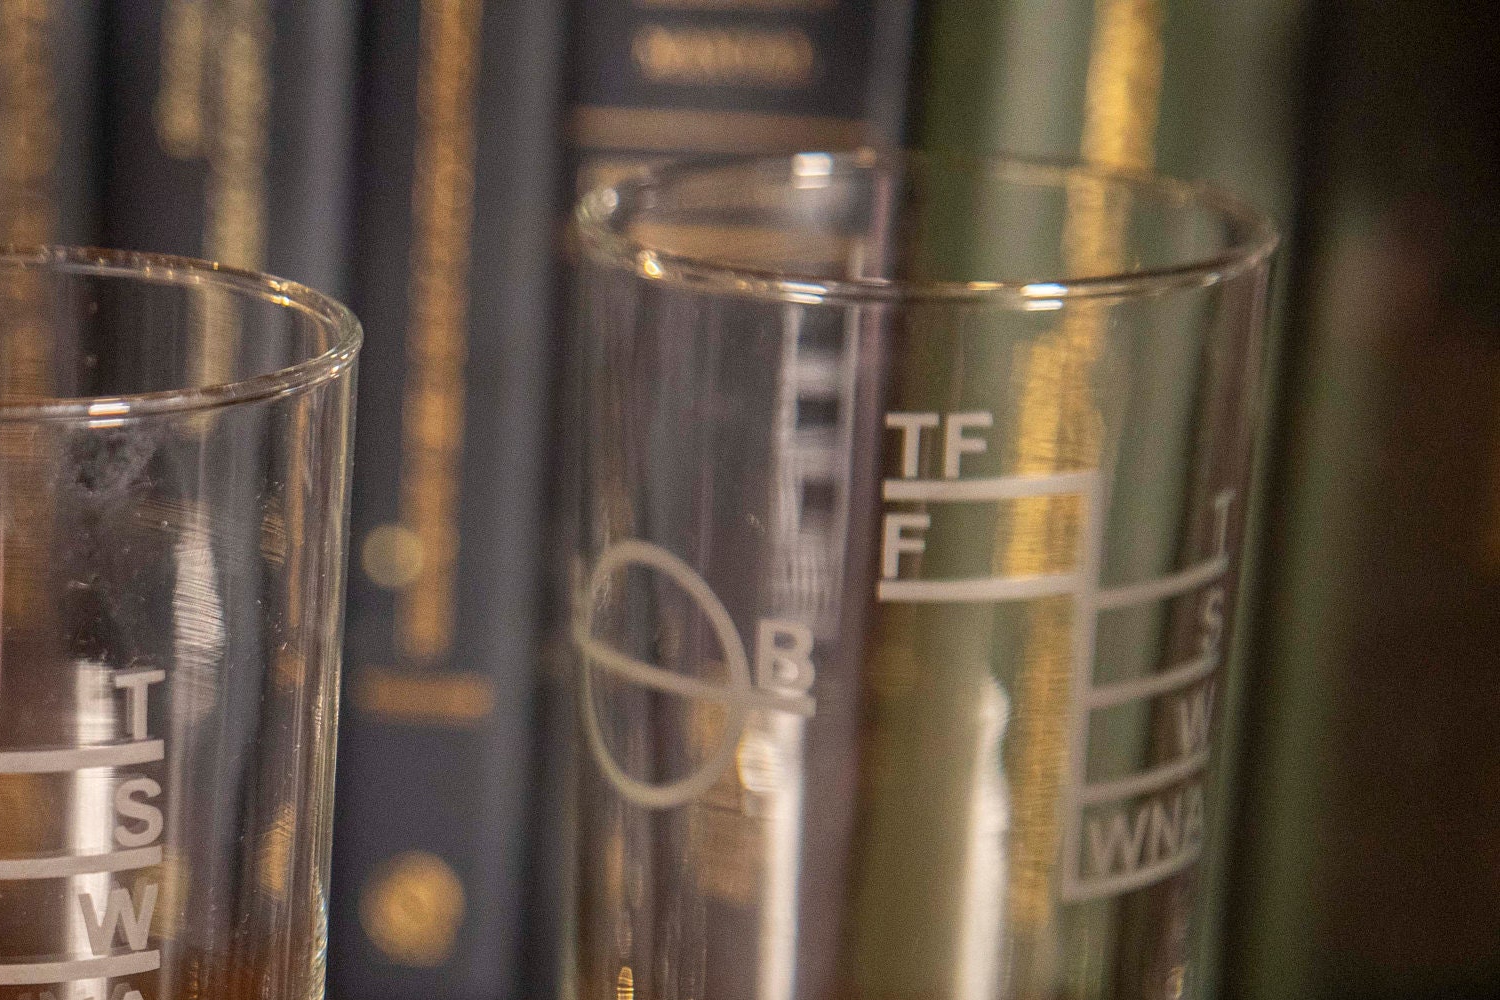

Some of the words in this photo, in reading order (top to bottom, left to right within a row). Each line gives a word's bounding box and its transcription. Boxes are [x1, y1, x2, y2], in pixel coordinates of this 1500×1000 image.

[885, 411, 993, 478] TF
[882, 514, 931, 579] F
[756, 617, 817, 692] B
[114, 668, 166, 741] T
[113, 776, 165, 849] S
[77, 883, 159, 954] W
